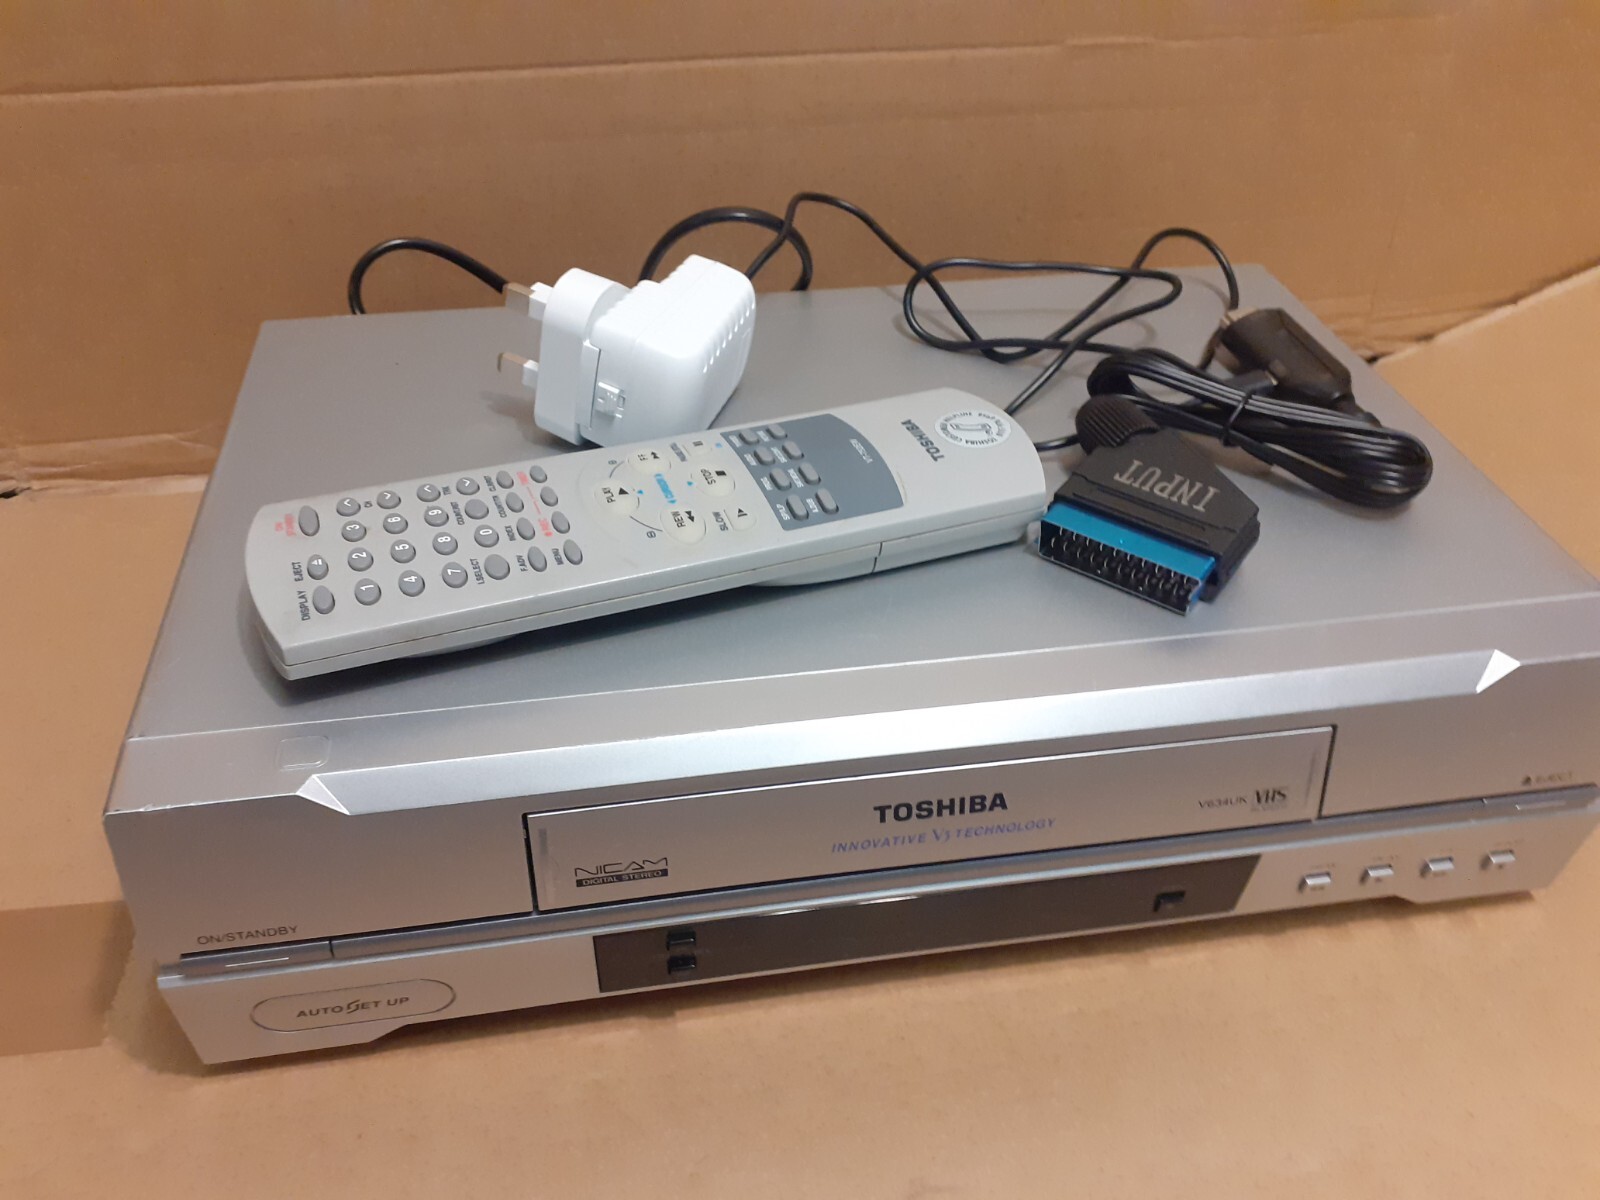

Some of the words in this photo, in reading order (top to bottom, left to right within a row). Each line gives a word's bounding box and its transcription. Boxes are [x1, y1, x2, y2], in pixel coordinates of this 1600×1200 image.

[901, 419, 944, 462] TOSHIBA
[700, 468, 716, 486] STOP
[1113, 459, 1220, 513] INPUT
[601, 487, 616, 504] PLAY
[671, 510, 686, 529] REW
[712, 511, 729, 531] SLOW
[395, 543, 409, 551] 5
[552, 548, 565, 566] MENU
[292, 561, 303, 582] EJECT
[447, 568, 461, 576] 7
[297, 590, 310, 621] DISPLAY
[873, 792, 1008, 823] TOSHIBA
[831, 831, 926, 853] INNOVATIVE
[955, 818, 1057, 839] TECHNOLOGY
[574, 857, 668, 877] NICAM
[582, 876, 618, 886] DIGITAL
[622, 870, 662, 881] STEREO
[197, 925, 298, 945] ON/STANDBY
[296, 1005, 343, 1018] AUTO
[387, 996, 410, 1006] UP
